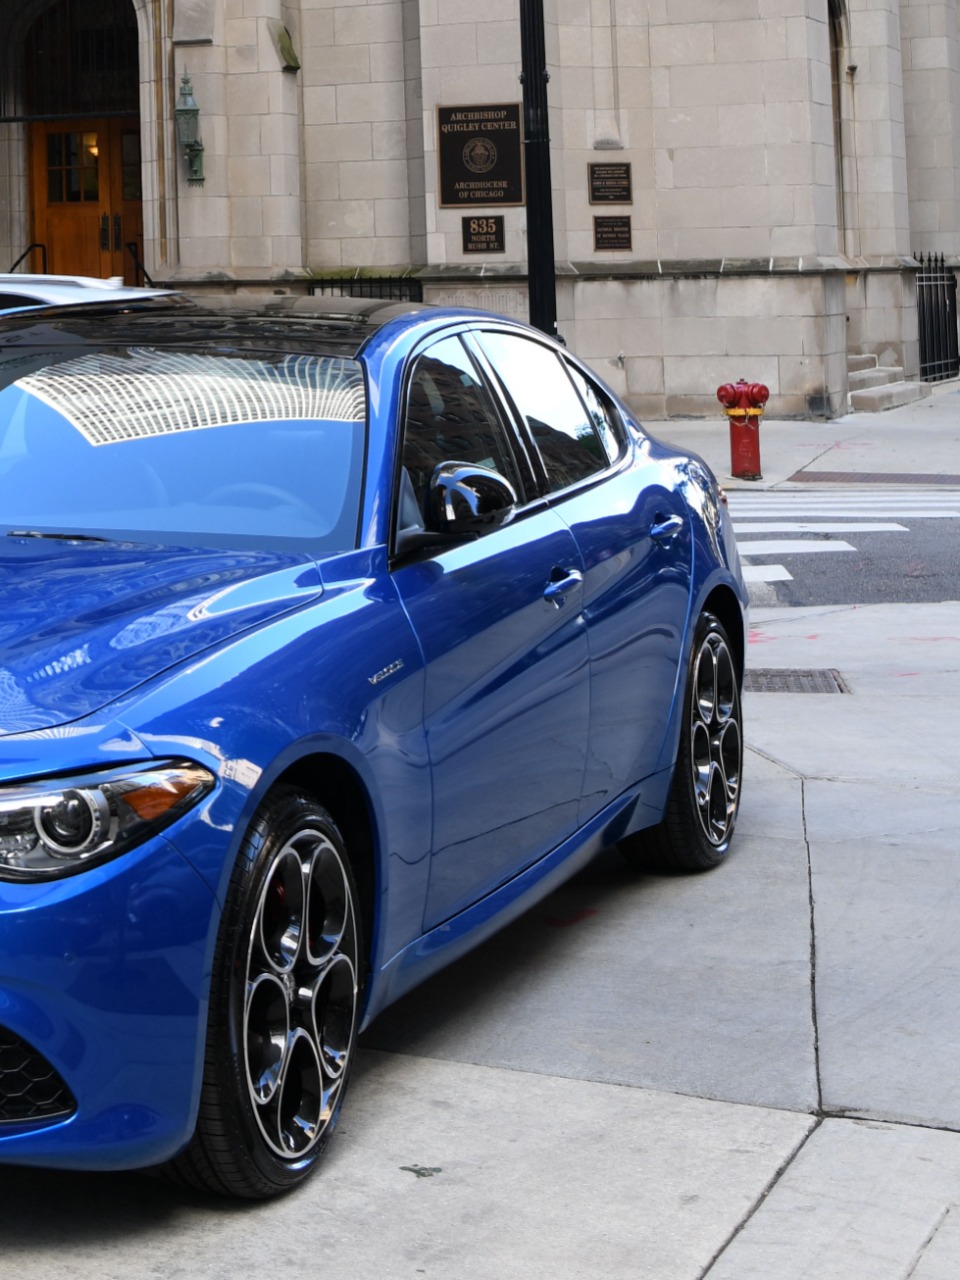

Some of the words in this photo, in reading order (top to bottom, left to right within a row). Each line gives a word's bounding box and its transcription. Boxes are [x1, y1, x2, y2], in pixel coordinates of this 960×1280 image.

[450, 110, 507, 121] ARCHBISHOP
[441, 123, 480, 133] QUIGLEY
[481, 121, 517, 130] CENTER
[454, 181, 508, 189] ARCHDIOCESE
[470, 190, 504, 198] CHICAGO
[470, 219, 496, 233] 835
